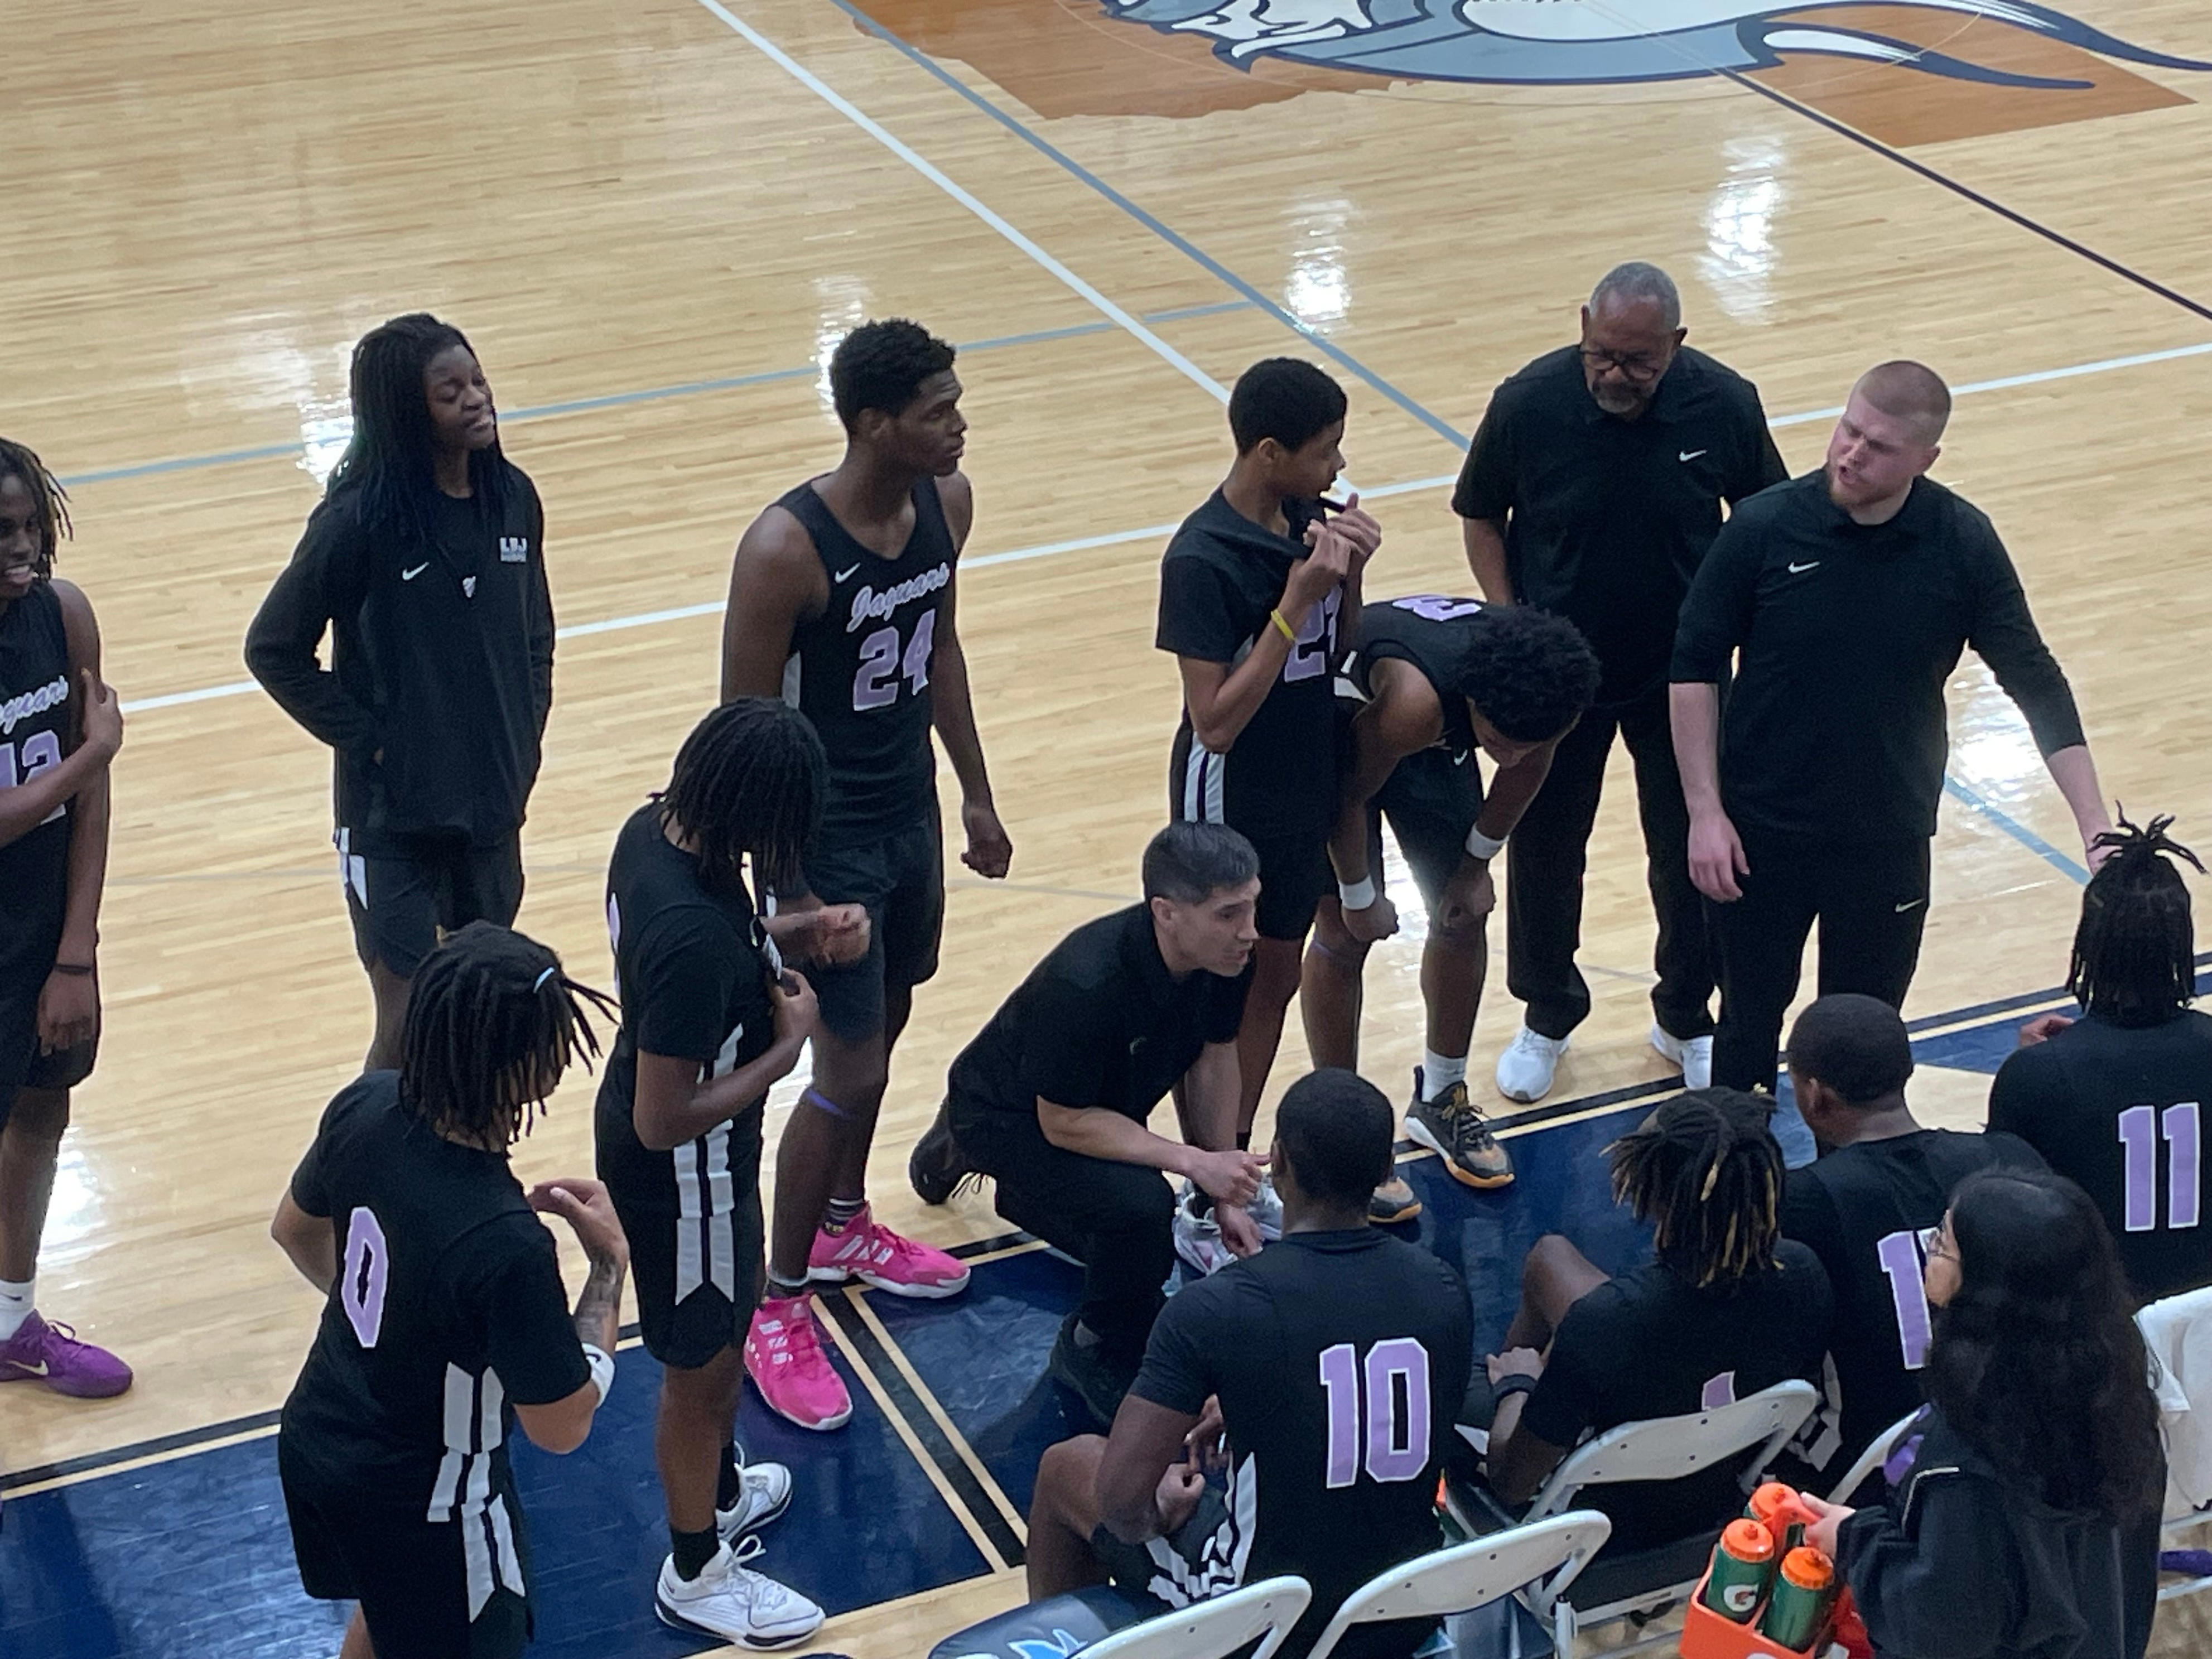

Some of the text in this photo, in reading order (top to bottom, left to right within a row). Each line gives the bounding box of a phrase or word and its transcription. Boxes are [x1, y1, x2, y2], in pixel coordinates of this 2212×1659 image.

[846, 562, 950, 633] Jaguars
[853, 608, 936, 711] 24
[2118, 1102, 2200, 1232] 11
[341, 1206, 389, 1348] 0
[1319, 1337, 1431, 1489] 10
